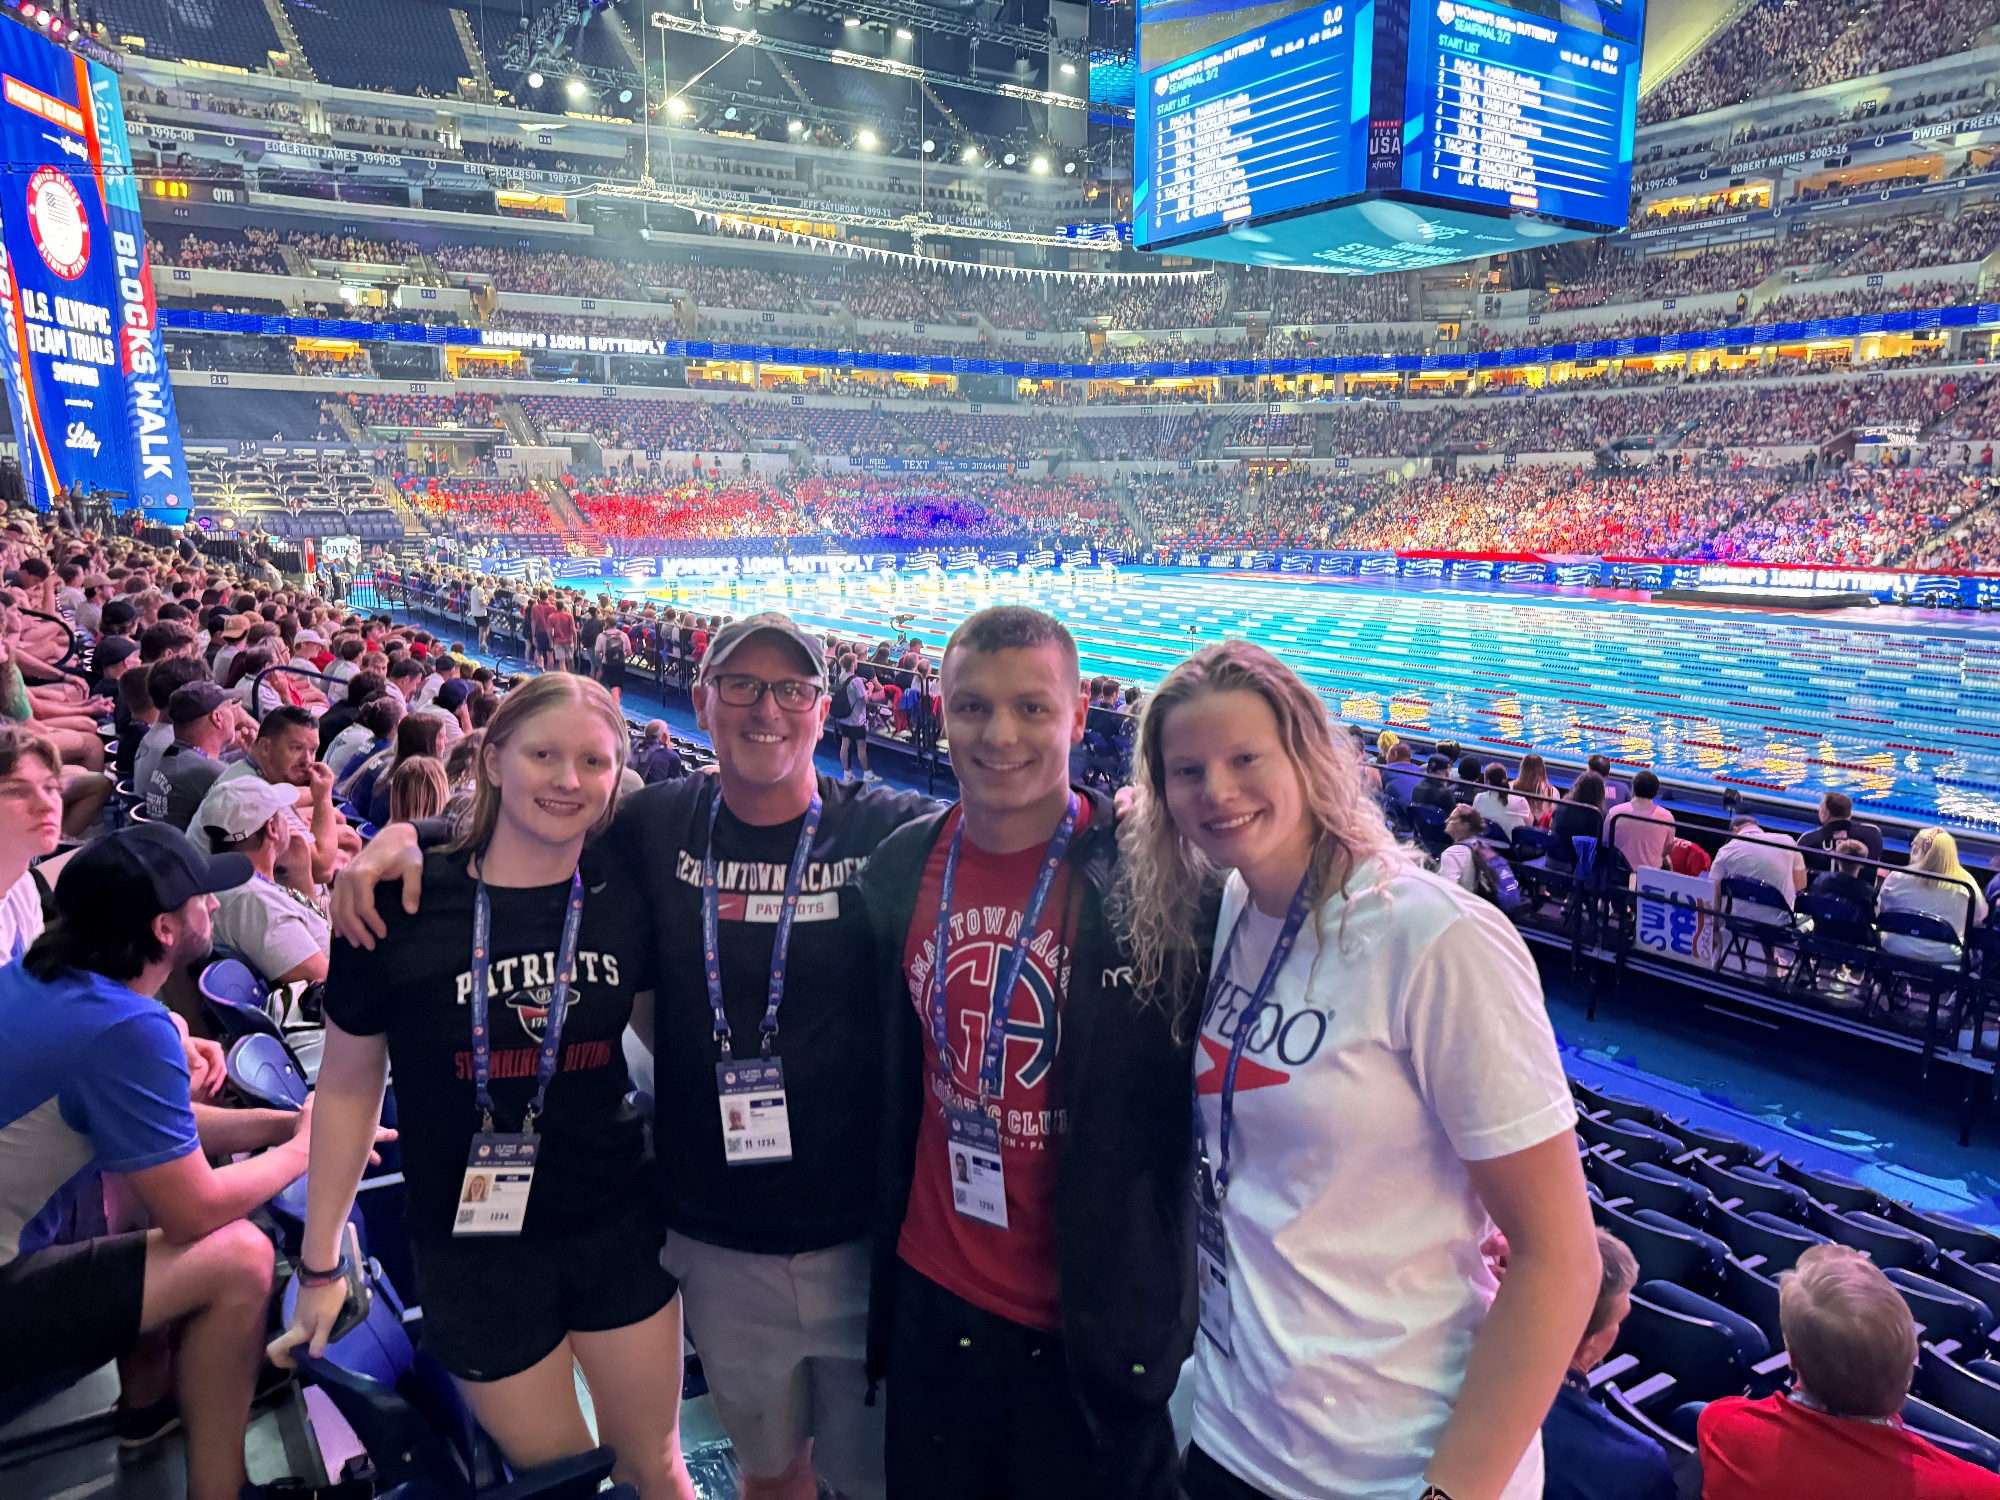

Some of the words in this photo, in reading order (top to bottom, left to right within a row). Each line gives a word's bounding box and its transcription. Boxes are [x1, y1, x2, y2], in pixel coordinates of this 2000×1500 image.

[1454, 18, 1496, 41] SEMIFINAL
[1497, 29, 1511, 44] 2/2
[1438, 34, 1464, 50] START
[1464, 41, 1480, 54] LIST
[151, 125, 195, 142] 1996-08
[1375, 128, 1398, 137] TEAM
[1912, 125, 1958, 140] DWIGHT
[265, 141, 319, 158] EDGERRIN
[322, 150, 357, 162] JAMES
[363, 153, 401, 167] 1999-05
[1369, 137, 1401, 155] USA
[1372, 161, 1397, 171] xfinity
[1731, 158, 1767, 174] ROBERT
[1769, 152, 1805, 169] MATHIS
[1810, 143, 1848, 160] 2003-16
[549, 173, 582, 185] 1987-91
[1645, 176, 1678, 191] 1997-06
[213, 187, 235, 203] QTR
[800, 201, 818, 211] JEFF
[821, 203, 859, 215] SATURDAY
[863, 206, 892, 218] 1999-11
[937, 214, 955, 224] BILL
[956, 217, 983, 227] POLIAN
[22, 288, 53, 323] U.S.
[54, 296, 112, 335] OLYMPIC
[113, 231, 157, 375] BLOCKS
[25, 323, 68, 358] TEAM
[68, 331, 115, 366] TRIALS
[482, 330, 547, 348] WOMEN'S
[550, 334, 586, 350] 100M
[588, 336, 667, 354] BUTTERFLY
[133, 381, 173, 480] WALK
[65, 421, 102, 458] Lilly
[240, 441, 256, 450] 114
[902, 460, 930, 470] TEXT
[971, 462, 1016, 471] 317.644.HEP
[325, 545, 359, 554] PARS
[662, 557, 741, 577] WOMEN'S
[788, 555, 875, 575] BUTTERFLY
[1699, 567, 1767, 584] WOMEN'S
[1769, 570, 1814, 588] 100M
[1816, 571, 1920, 593] BUTTERFLY
[676, 850, 788, 892] GERANTOWN
[756, 902, 824, 916] PATOTS
[1030, 1140, 1045, 1151] PA
[490, 1212, 509, 1221] 1234
